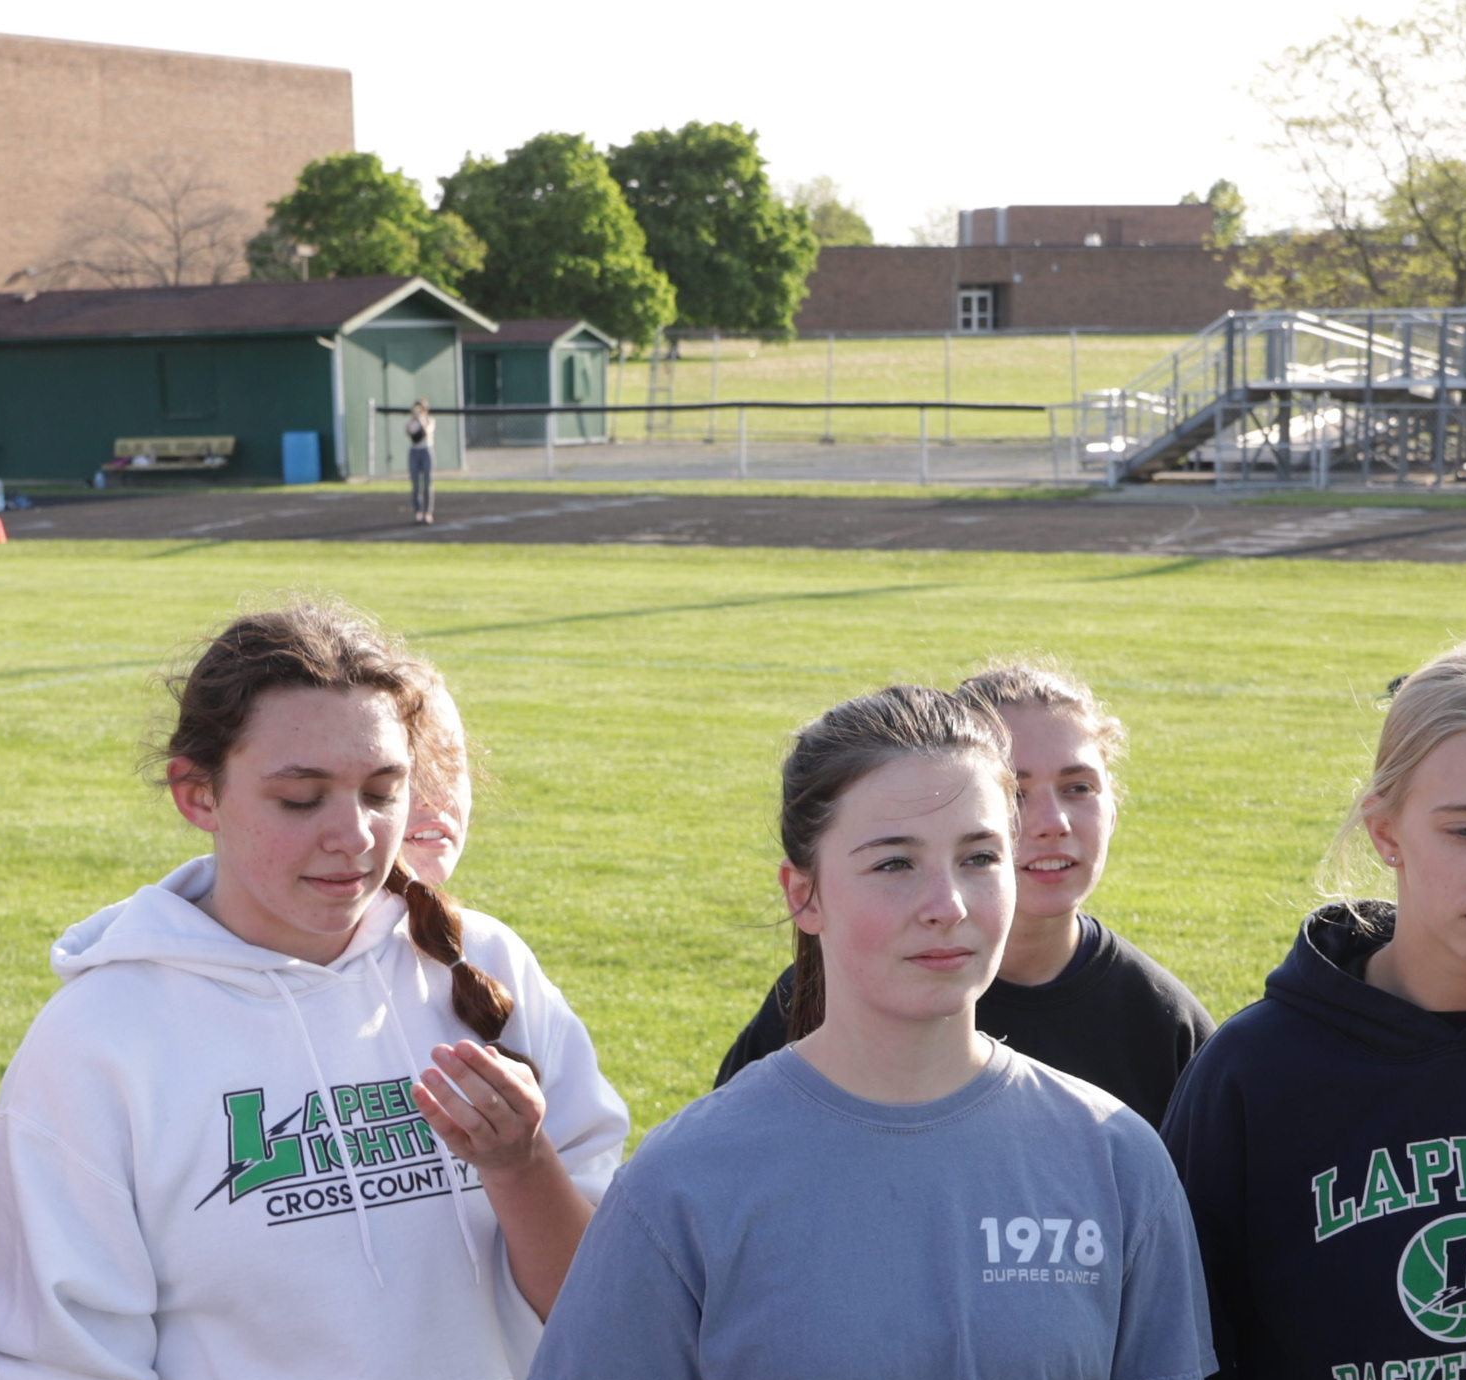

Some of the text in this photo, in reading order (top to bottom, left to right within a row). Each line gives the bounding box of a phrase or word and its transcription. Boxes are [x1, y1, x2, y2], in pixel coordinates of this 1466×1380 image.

[266, 1182, 353, 1218] CROSS
[980, 1216, 1104, 1266] 1978
[983, 1268, 1101, 1285] DUPREE DANCE
